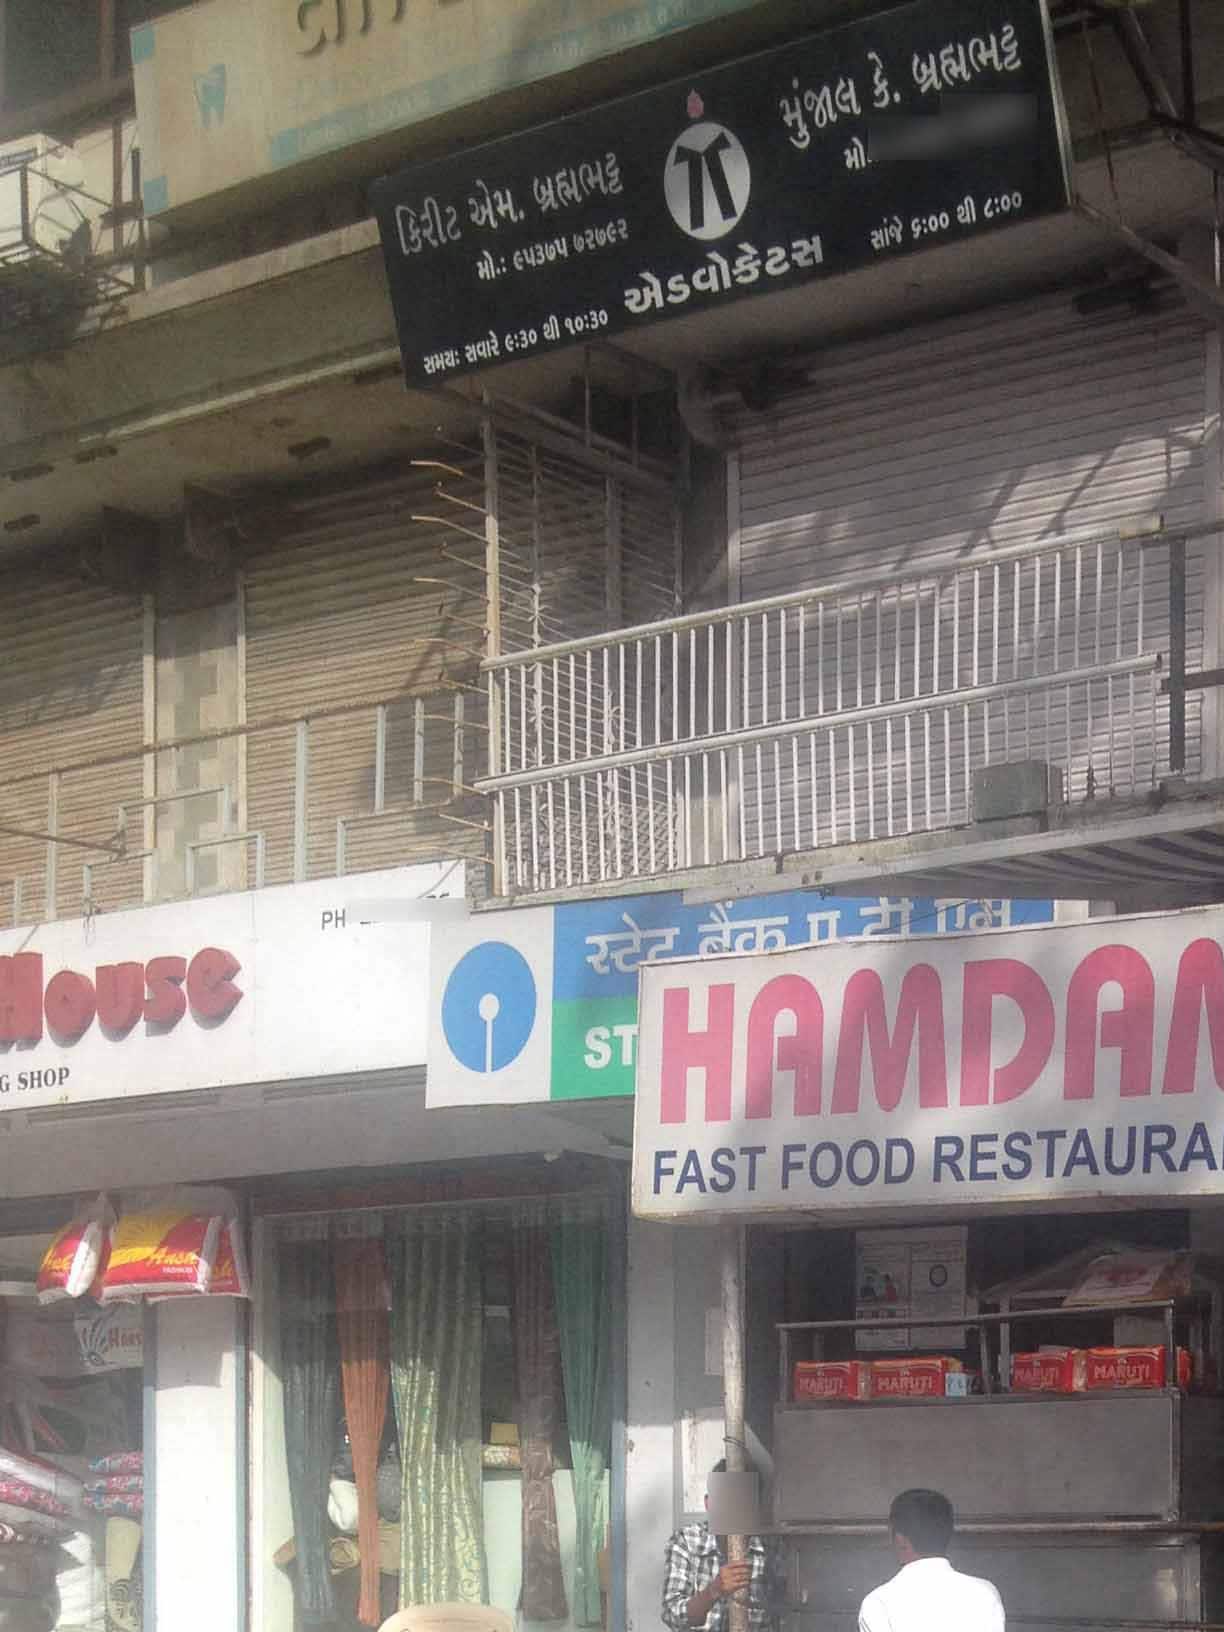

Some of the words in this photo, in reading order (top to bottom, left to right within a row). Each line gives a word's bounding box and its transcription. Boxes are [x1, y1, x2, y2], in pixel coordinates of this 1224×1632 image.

[957, 195, 976, 224] થી
[395, 197, 461, 254] કિરીટ
[543, 315, 560, 340] થી
[17, 1066, 71, 1091] SHOP
[653, 1145, 767, 1195] FAST
[781, 1136, 915, 1190] FOOD
